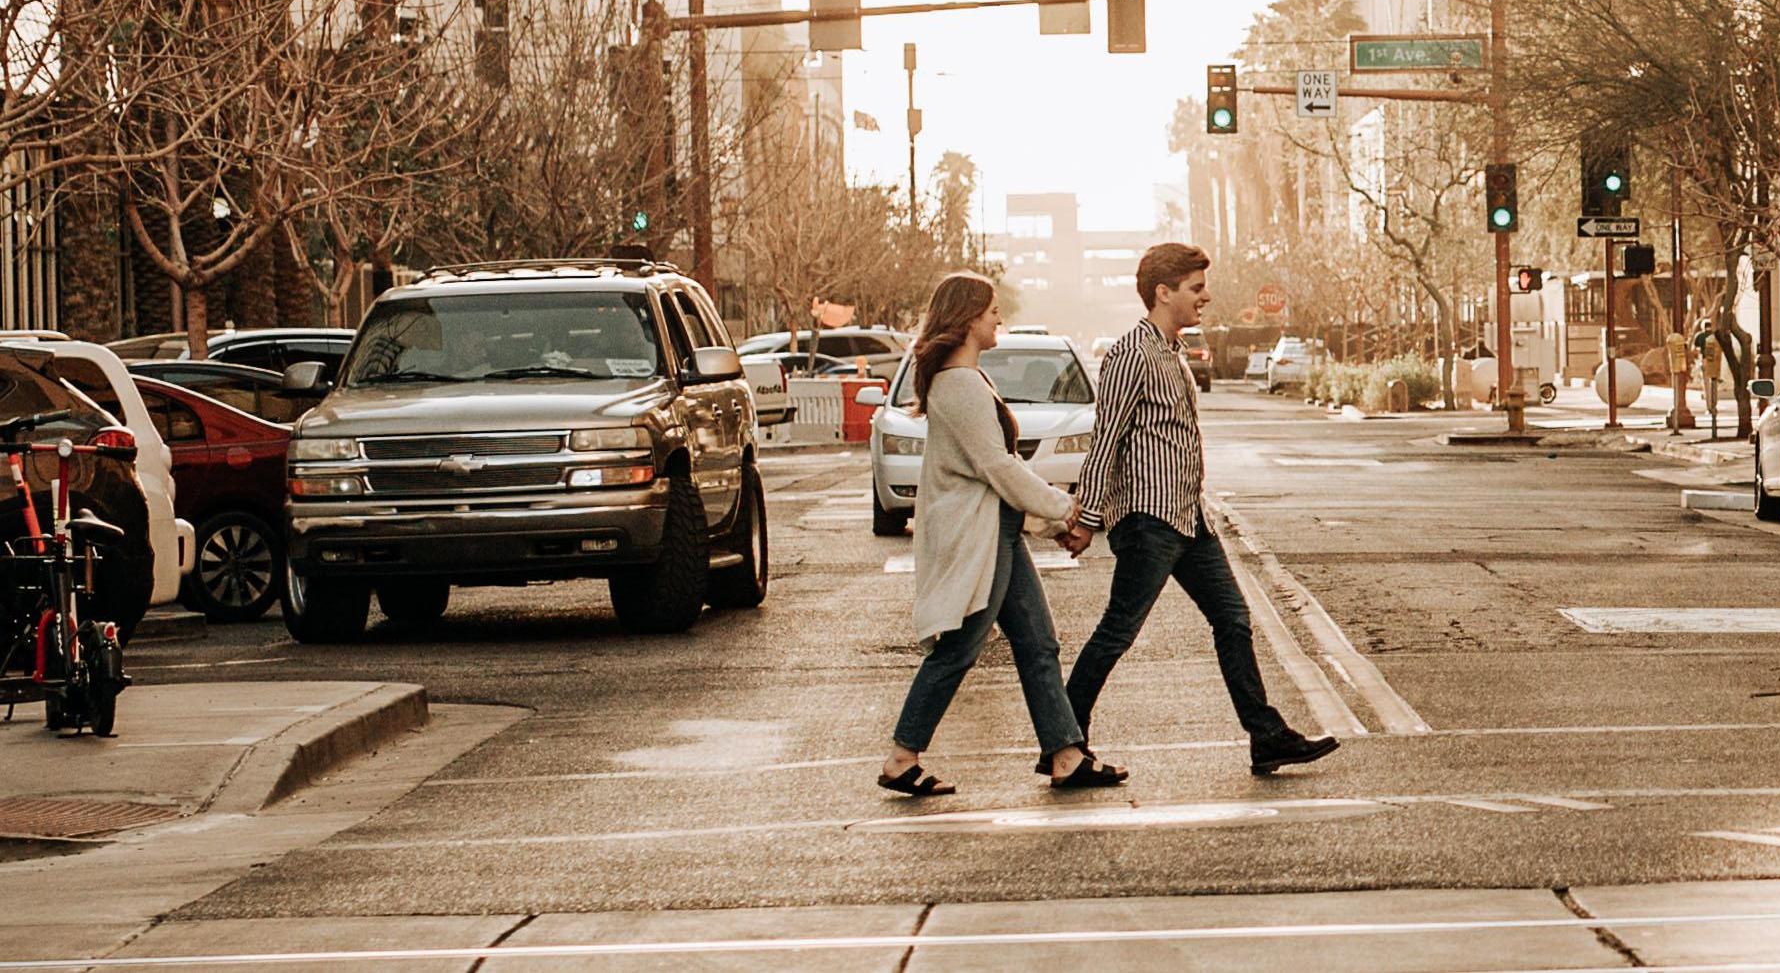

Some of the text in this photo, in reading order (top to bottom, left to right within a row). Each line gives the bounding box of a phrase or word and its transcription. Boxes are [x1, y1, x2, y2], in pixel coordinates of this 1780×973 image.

[1368, 47, 1431, 62] 1st Ave.
[1303, 73, 1331, 86] ONE
[1303, 87, 1332, 100] WAY
[1615, 223, 1633, 232] WAY
